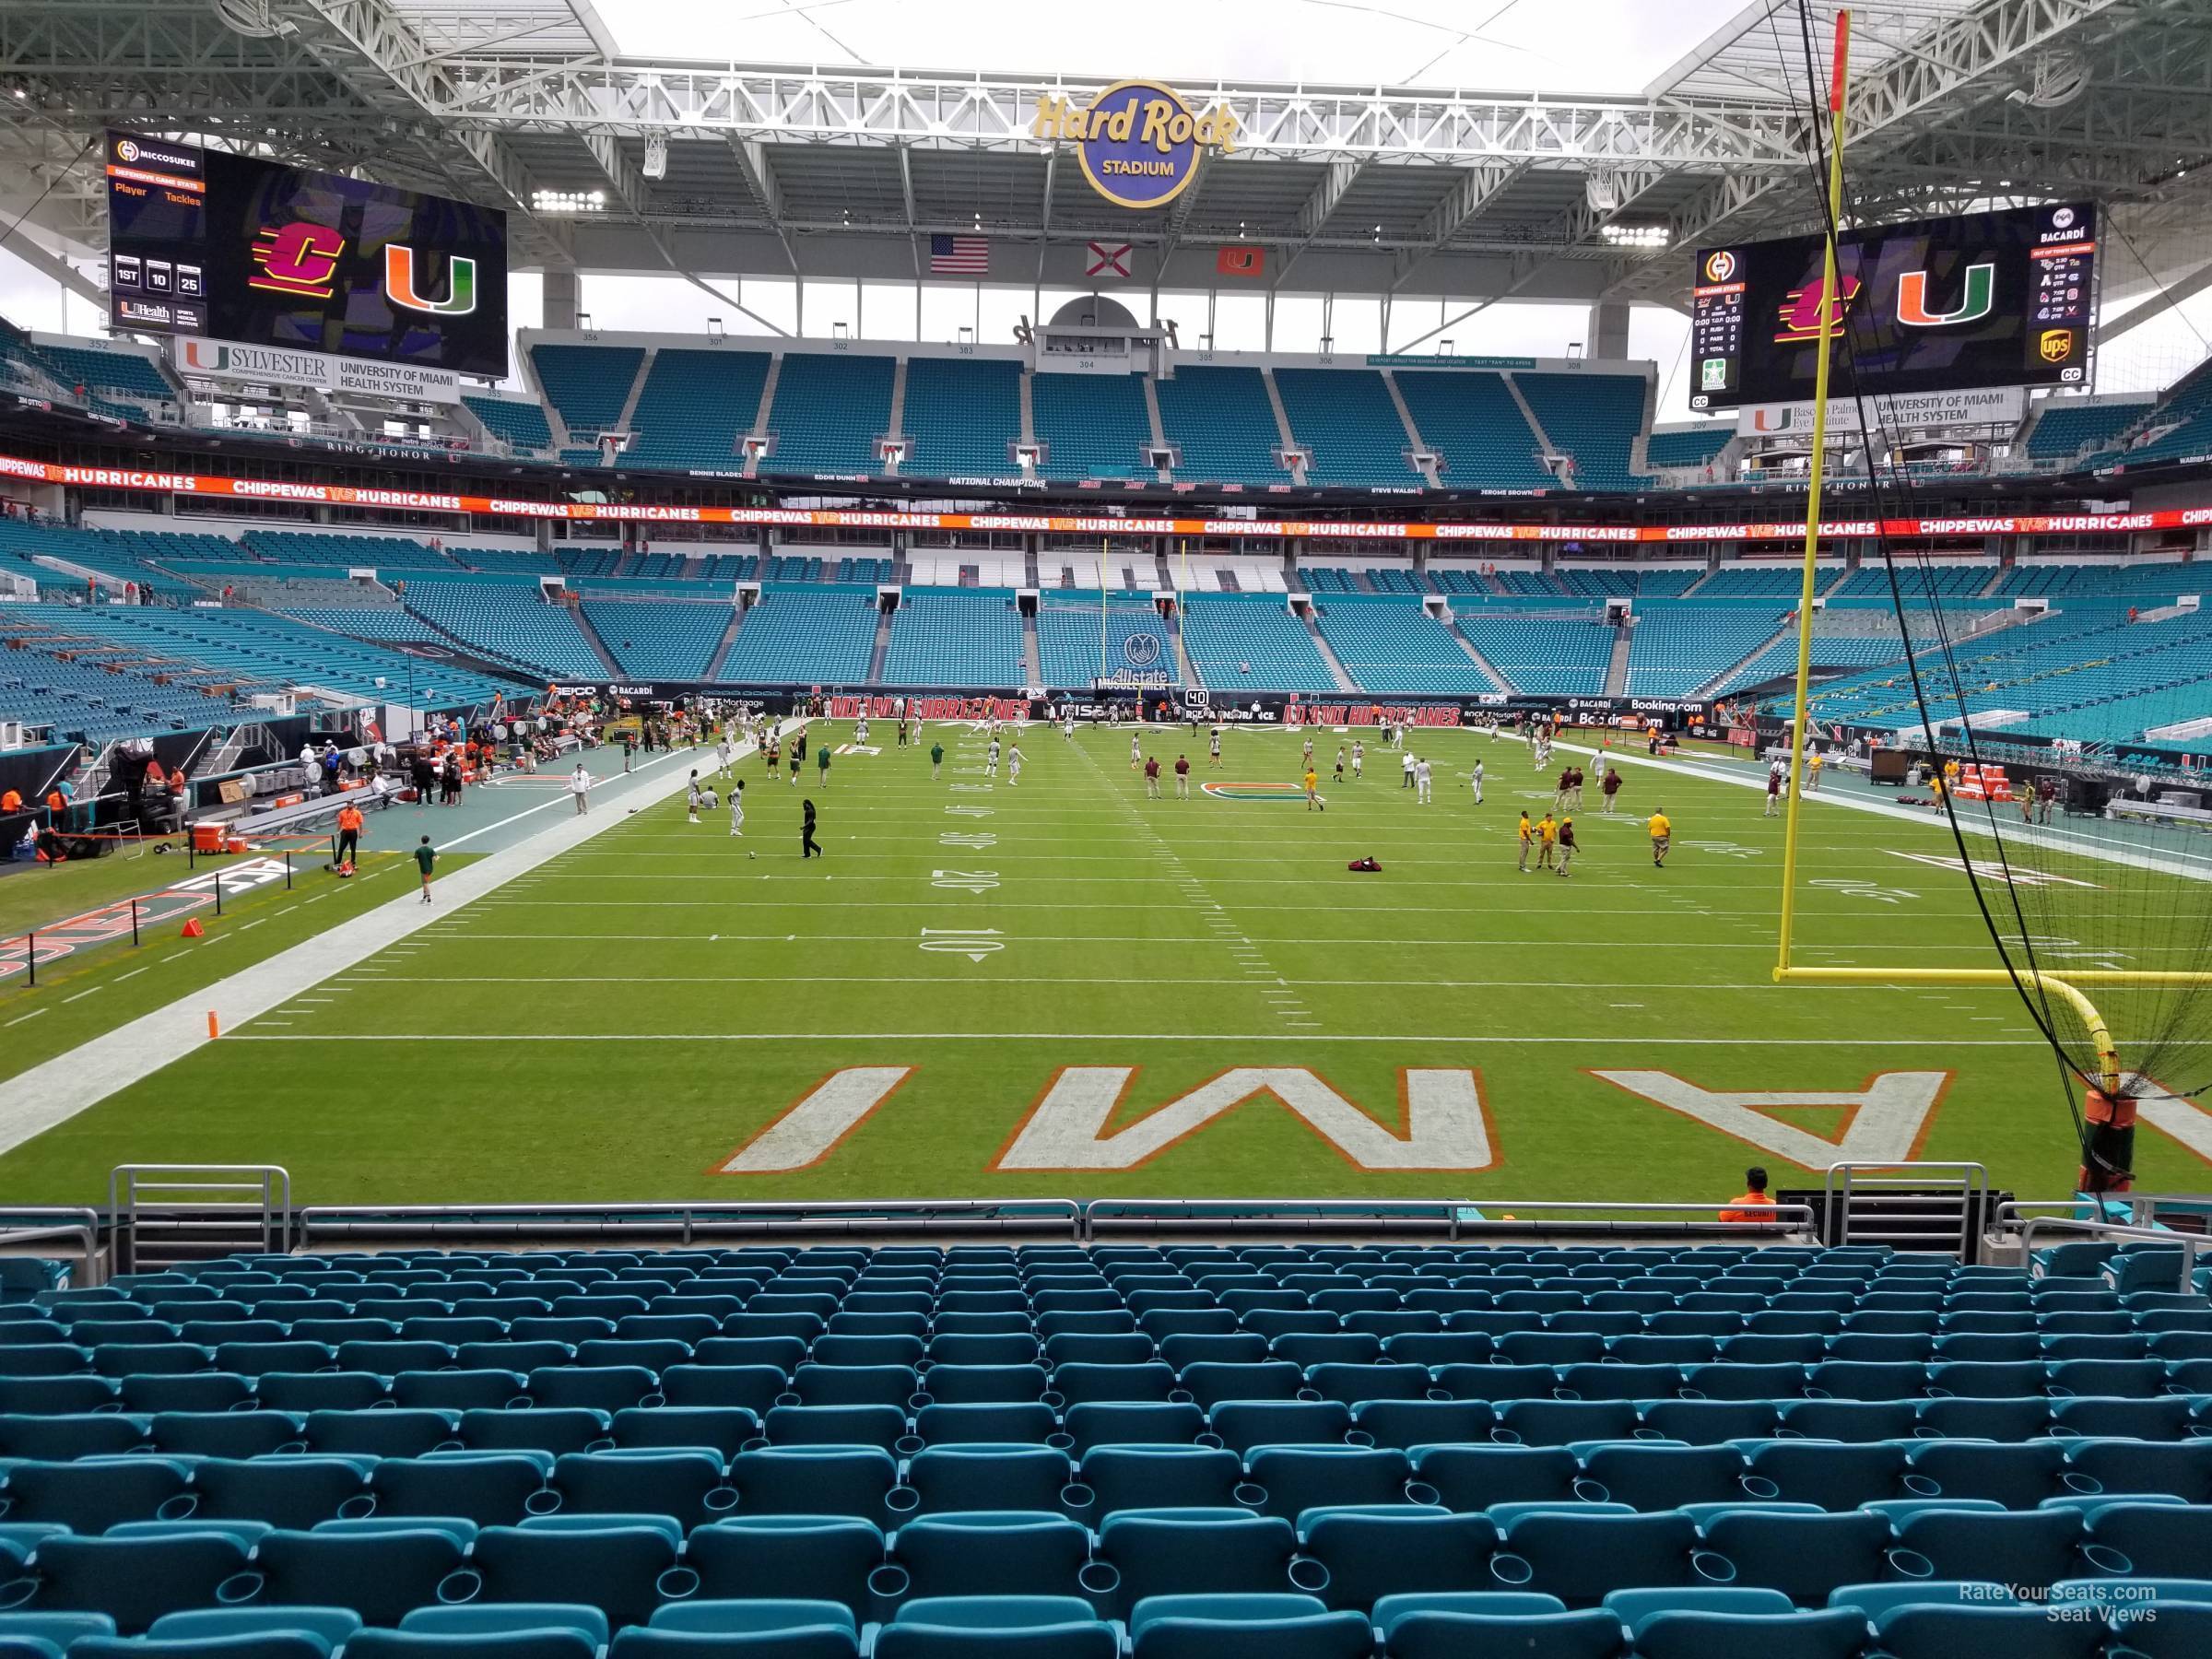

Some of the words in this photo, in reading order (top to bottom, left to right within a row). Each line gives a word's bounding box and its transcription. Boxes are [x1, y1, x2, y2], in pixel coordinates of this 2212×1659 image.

[1033, 95, 1138, 142] Hard
[1141, 99, 1238, 154] Rock
[140, 150, 195, 168] MICCOSUKEE
[1102, 159, 1174, 176] STADIUM
[115, 182, 147, 196] Player
[156, 177, 175, 185] GAME
[176, 180, 198, 189] STATS
[165, 192, 201, 206] Tackles
[118, 268, 137, 280] 1ST
[152, 275, 166, 286] 10
[385, 243, 476, 315] U
[181, 278, 197, 290] 25
[1897, 264, 1994, 325] U
[1695, 318, 1710, 326] 0:00
[88, 340, 109, 349] 352
[2042, 339, 2068, 357] ups
[186, 342, 229, 370] U
[231, 347, 326, 377] SYLVESTER
[1079, 360, 1094, 369] 304
[232, 368, 281, 381] COMPREHENSIVE
[283, 373, 305, 382] CANCER
[306, 376, 327, 384] CENTER
[340, 361, 401, 381] UNIVERSITY
[403, 369, 418, 381] OF
[419, 371, 453, 387] MIAMI
[2063, 371, 2079, 380] CC
[340, 375, 381, 392] HEALTH
[383, 381, 424, 396] SYSTEM
[486, 389, 502, 398] 355
[1694, 397, 1707, 406] CC
[1877, 396, 1944, 412] UNIVERSITY
[1946, 395, 1961, 406] OF
[1964, 394, 2004, 405] MIAMI
[1877, 412, 1920, 424] HEALTH
[1922, 409, 1968, 421] SYSTEM
[327, 442, 364, 454] RING
[379, 447, 430, 461] HONOR
[65, 468, 195, 489] HURRICANES
[948, 477, 992, 486] NATIONAL
[993, 478, 1045, 488] CHAMPIONS
[233, 481, 325, 499] CHIPPEWAS
[356, 489, 461, 509] HURRICANES
[489, 500, 568, 517] CHIPPEWAS
[596, 506, 700, 520] HURRICANES
[2182, 509, 2212, 524] CHIP
[731, 510, 812, 523] CHIPPEWAS
[840, 512, 940, 526] HURRICANES
[971, 516, 1049, 529] CHIPPEWAS
[1077, 518, 1174, 532] HURRICANES
[1920, 519, 2014, 533] CHIPPEWAS
[2049, 514, 2153, 530] HURRICANES
[1204, 522, 1282, 534] CHIPPEWAS
[1309, 524, 1406, 535] HURRICANES
[1435, 526, 1512, 538] CHIPPEWAS
[1539, 527, 1637, 540] HURRICANES
[1666, 525, 1747, 539] CHIPPEWAS
[1776, 522, 1876, 536] HURICANES
[1112, 667, 1167, 684] Allstate
[618, 686, 653, 695] BACARDÍ
[1189, 692, 1206, 703] 40
[724, 698, 764, 709] Mortgage
[1580, 699, 1611, 709] BACARDÍ
[1631, 699, 1702, 713] Booking.com
[919, 927, 1006, 953] 10
